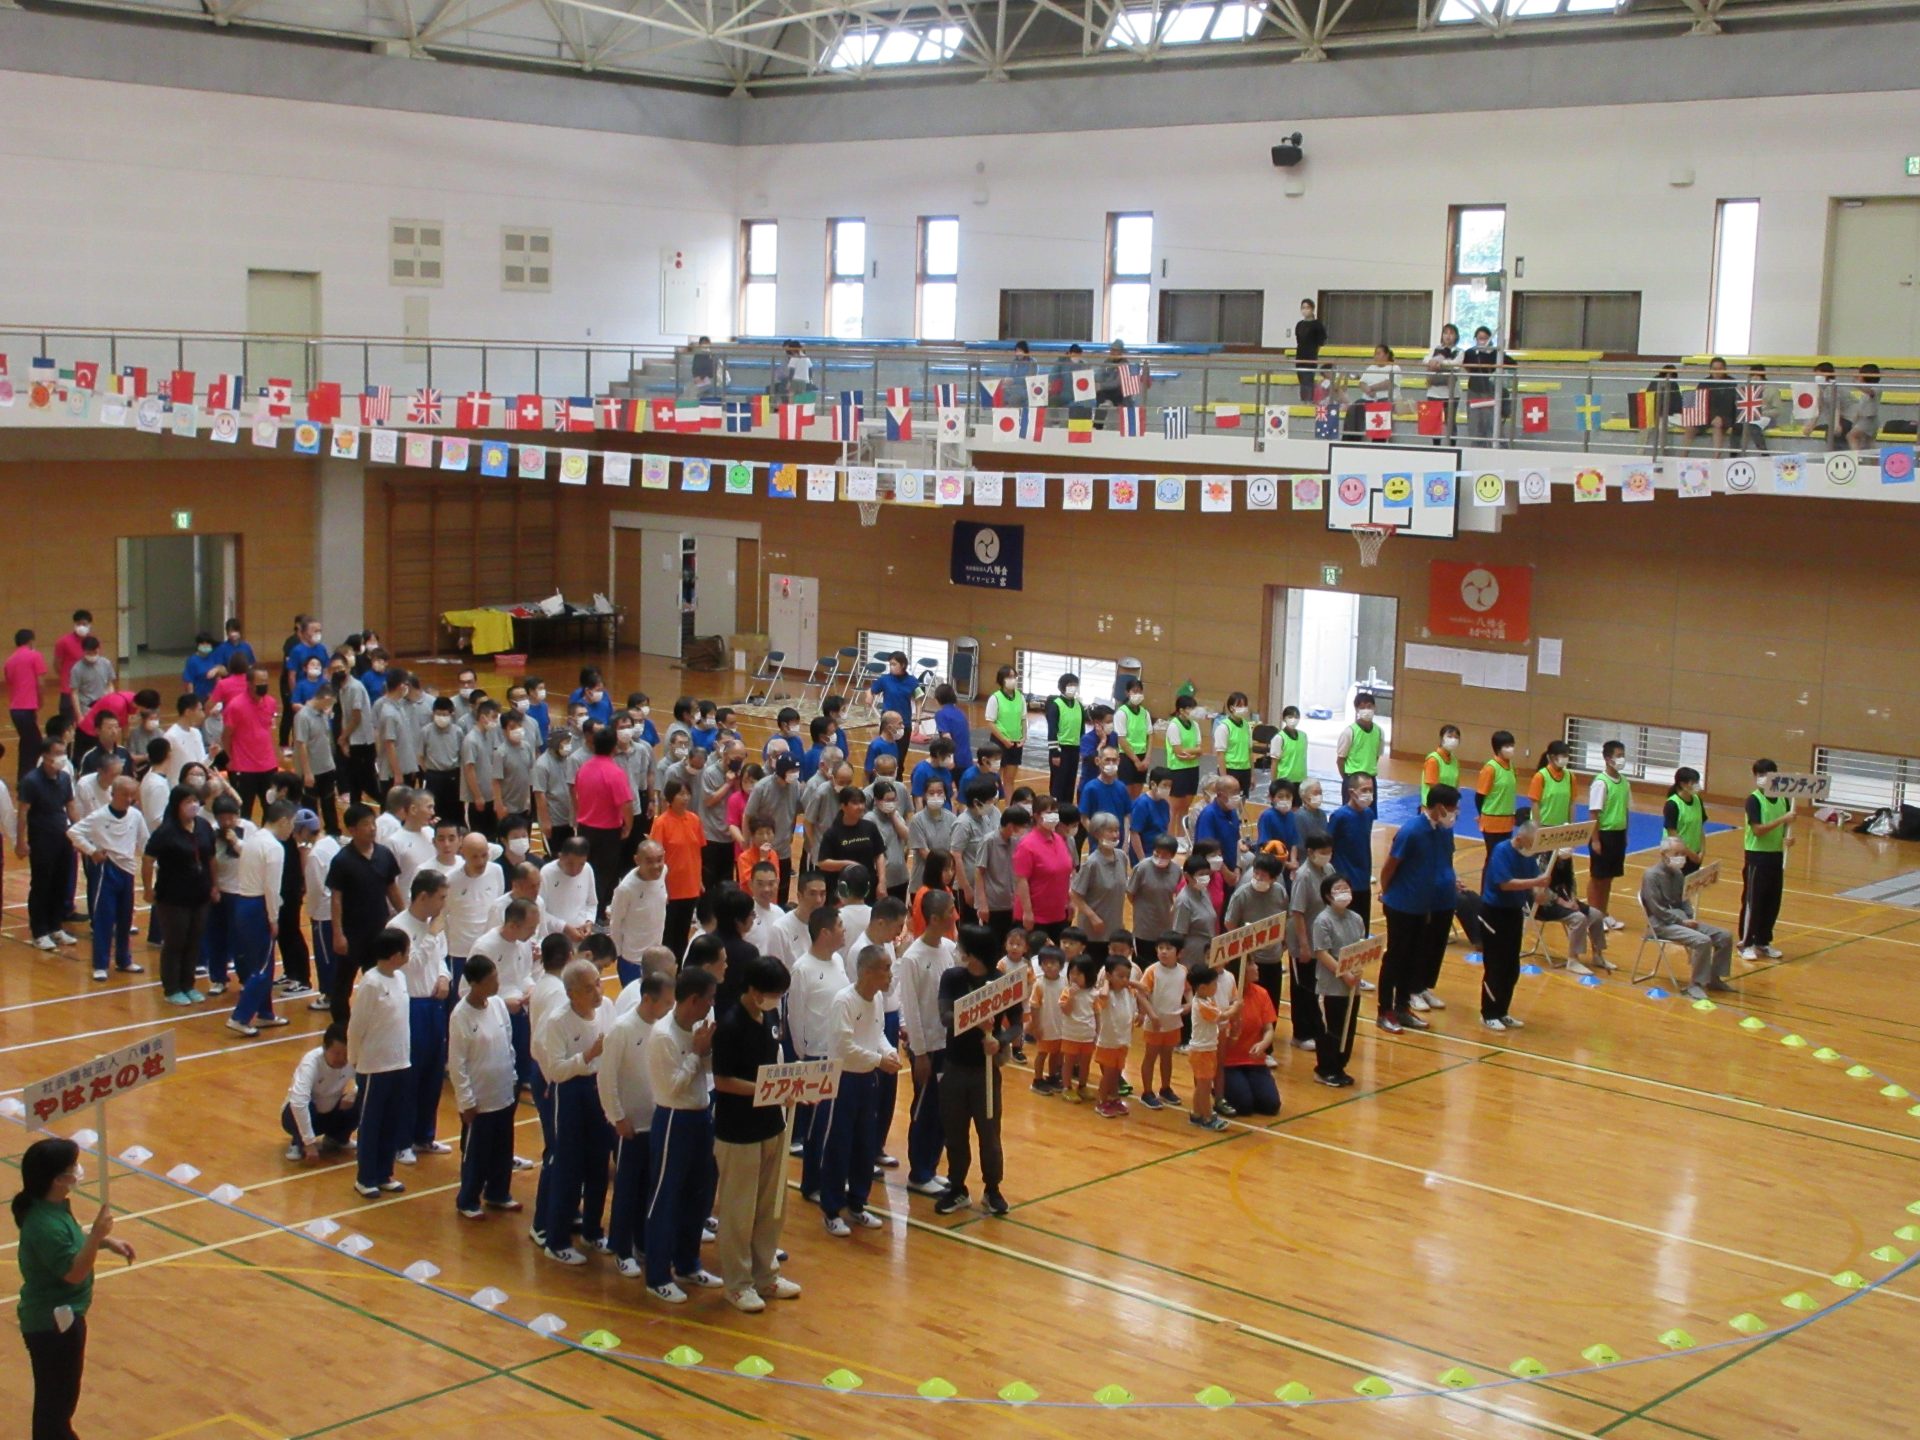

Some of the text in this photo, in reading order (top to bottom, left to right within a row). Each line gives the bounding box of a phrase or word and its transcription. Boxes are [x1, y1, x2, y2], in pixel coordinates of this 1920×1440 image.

[1769, 775, 1827, 794] ボランティア
[42, 1038, 163, 1093] 社会福祉法人 八幡会
[767, 1065, 809, 1079] 社会福祉法人
[760, 1074, 833, 1101] ケアホーム
